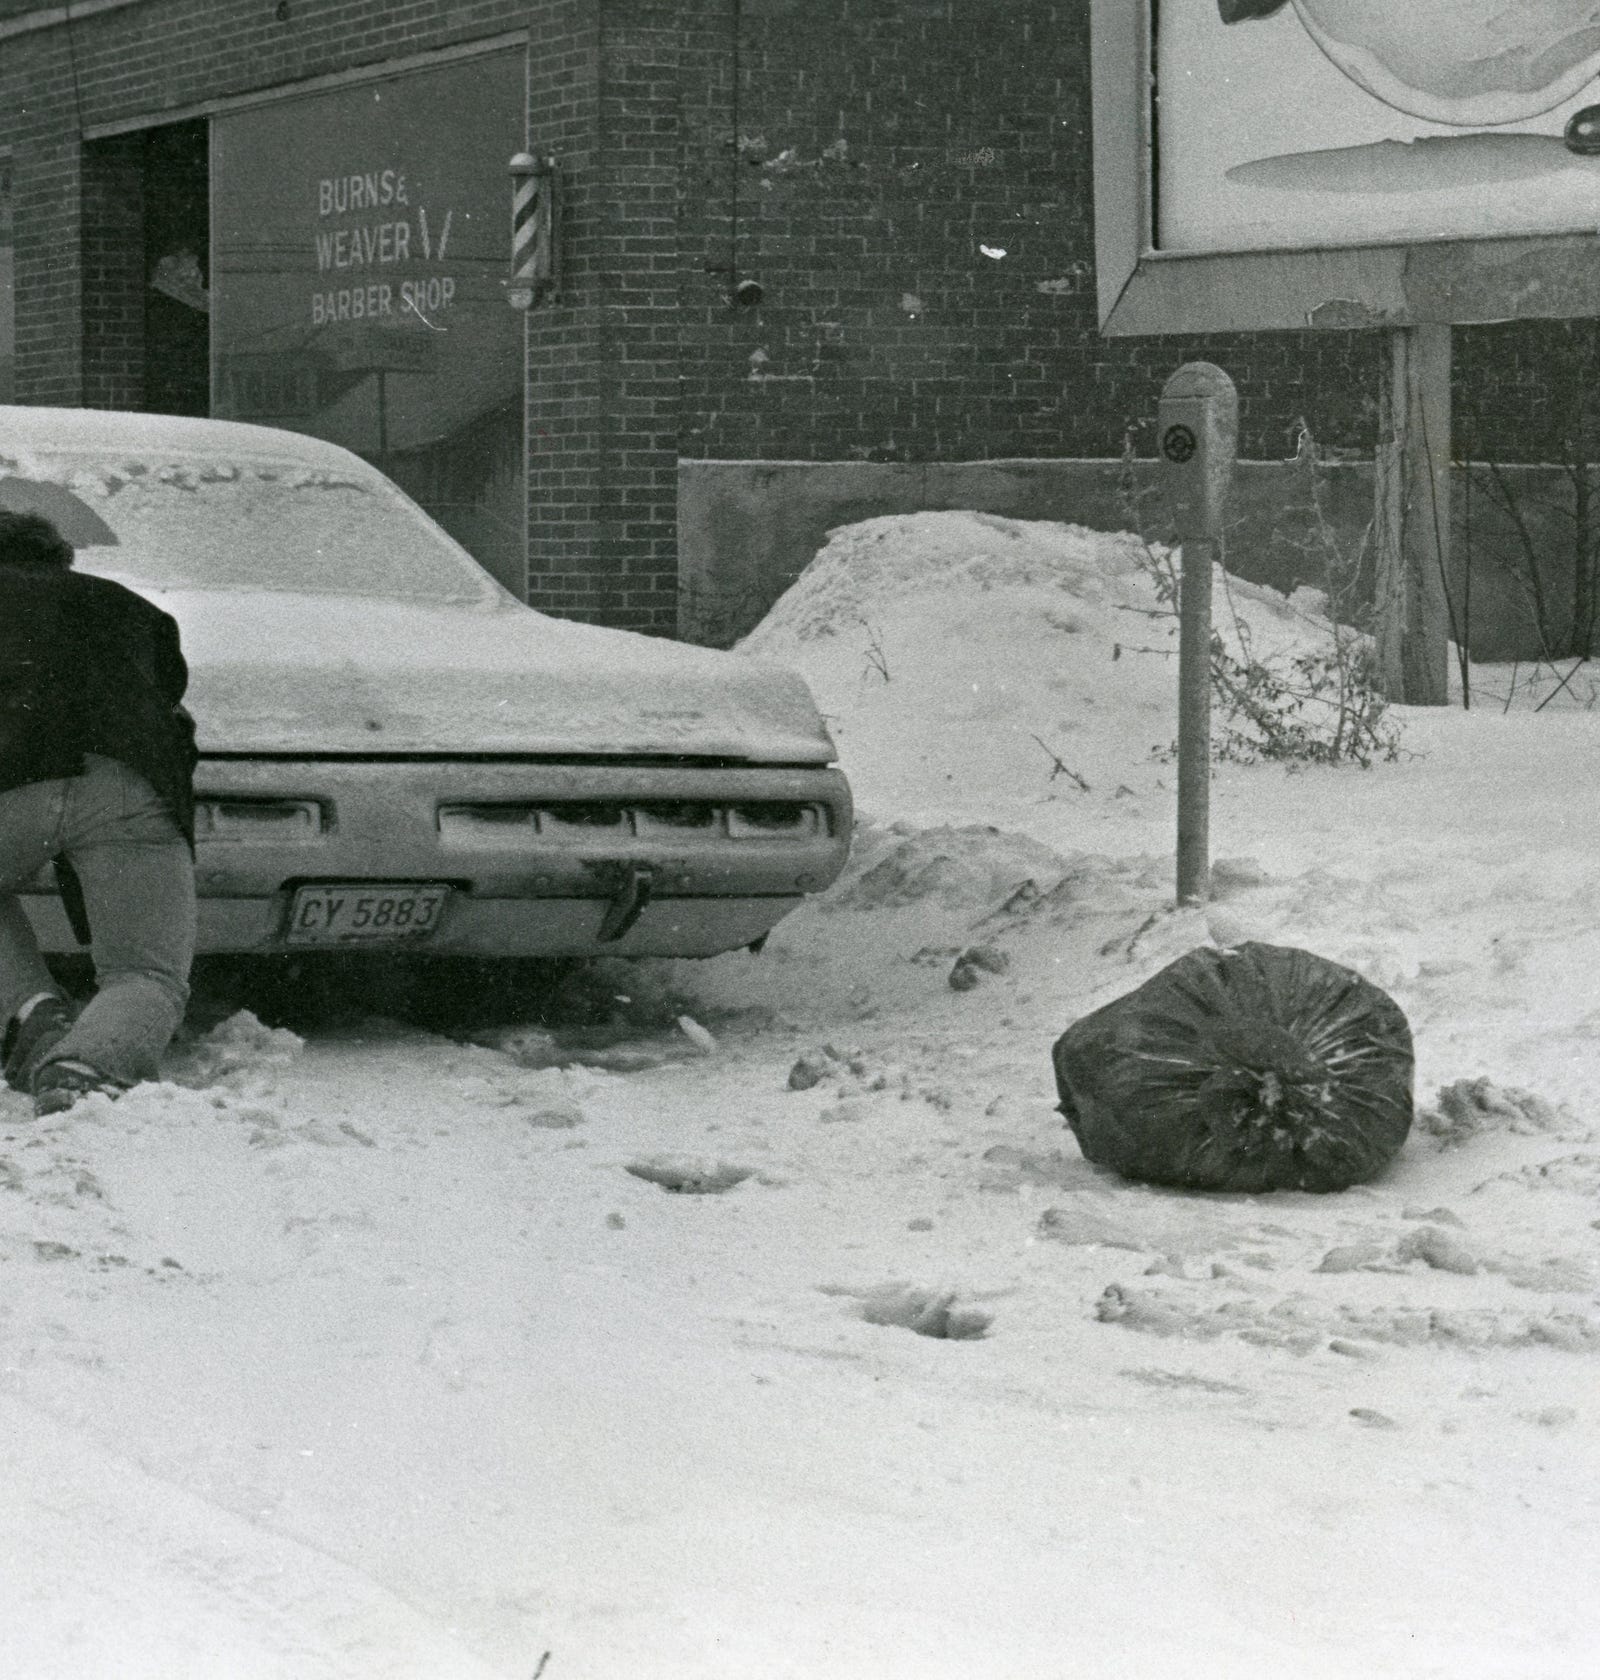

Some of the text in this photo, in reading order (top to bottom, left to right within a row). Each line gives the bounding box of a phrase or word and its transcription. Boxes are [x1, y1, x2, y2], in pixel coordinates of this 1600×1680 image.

[320, 170, 395, 215] BURNS
[316, 222, 410, 270] WEAVER
[313, 277, 455, 324] BARBER SHOP
[301, 898, 438, 927] CY 5883
